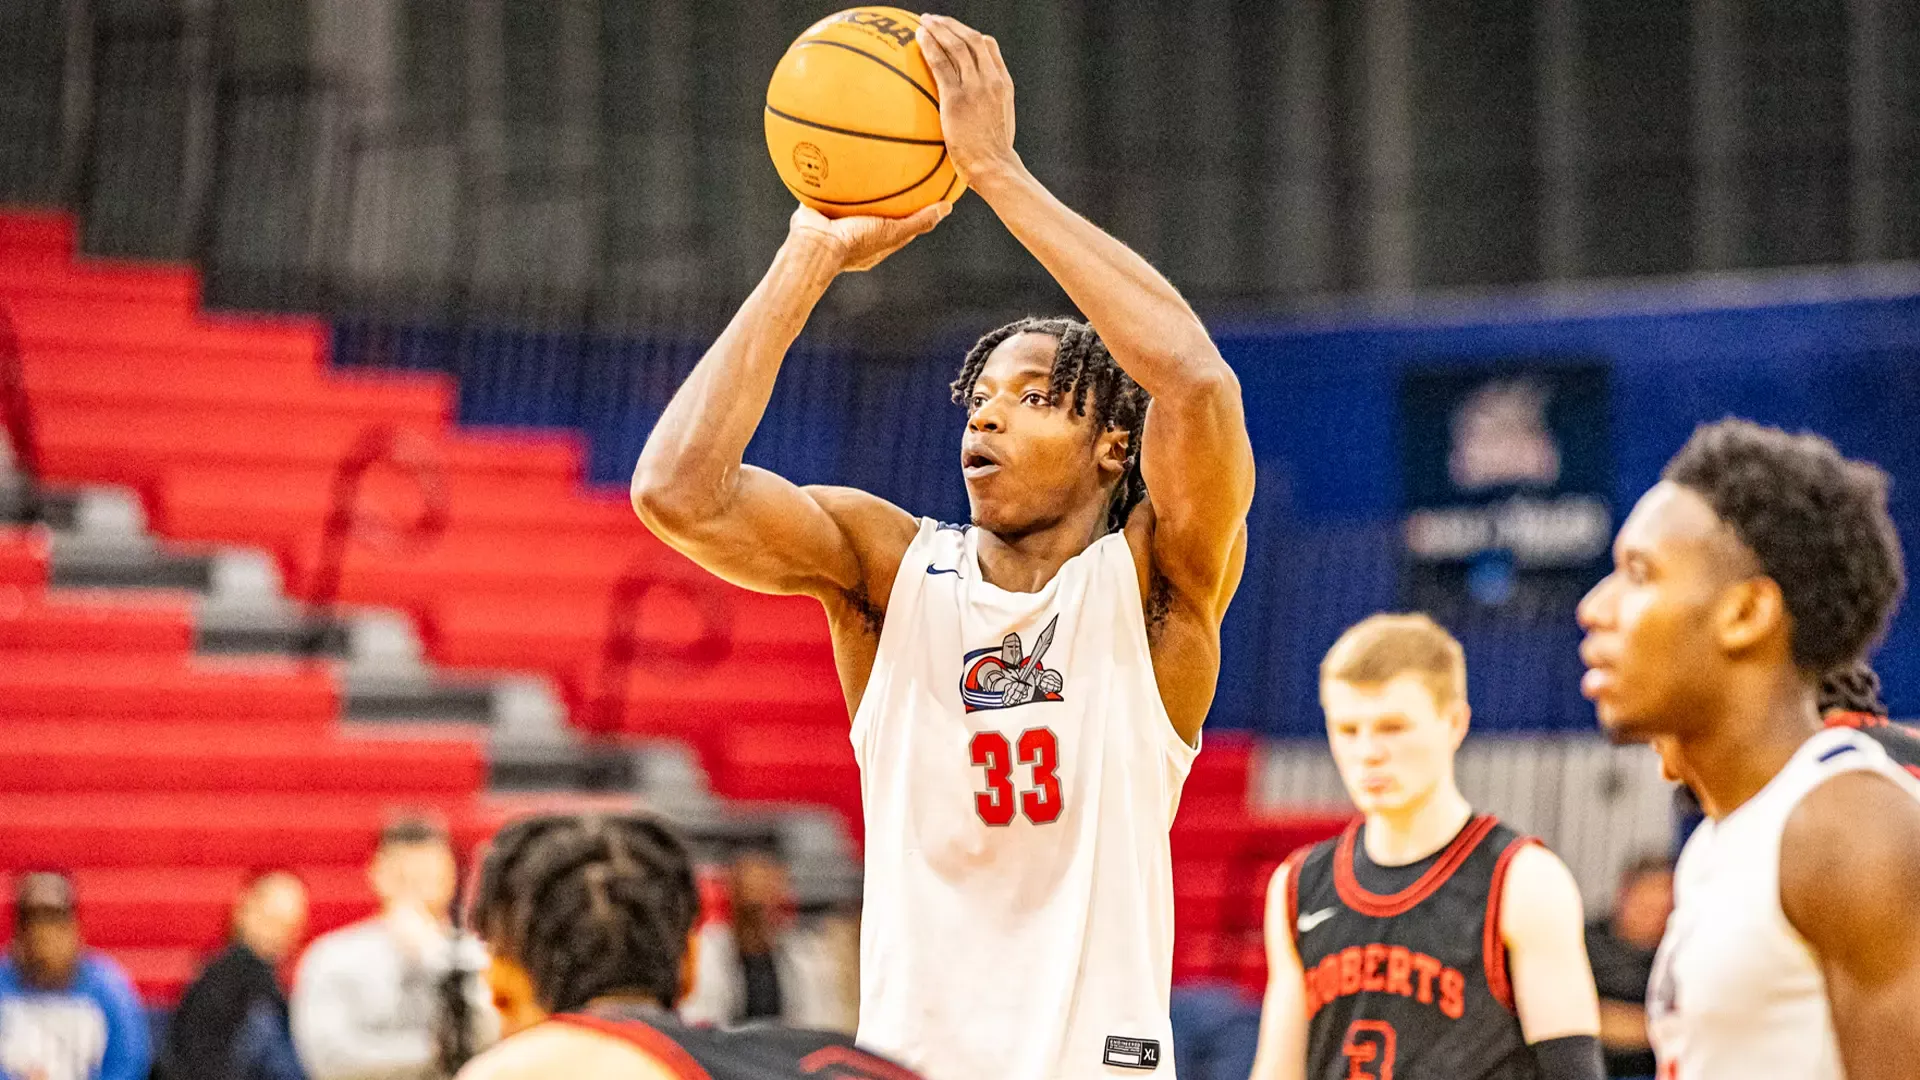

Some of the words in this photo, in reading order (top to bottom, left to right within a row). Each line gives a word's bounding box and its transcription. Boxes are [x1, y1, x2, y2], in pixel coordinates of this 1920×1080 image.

[837, 11, 916, 47] CAA
[968, 726, 1064, 827] 33
[1143, 1048, 1157, 1061] XL
